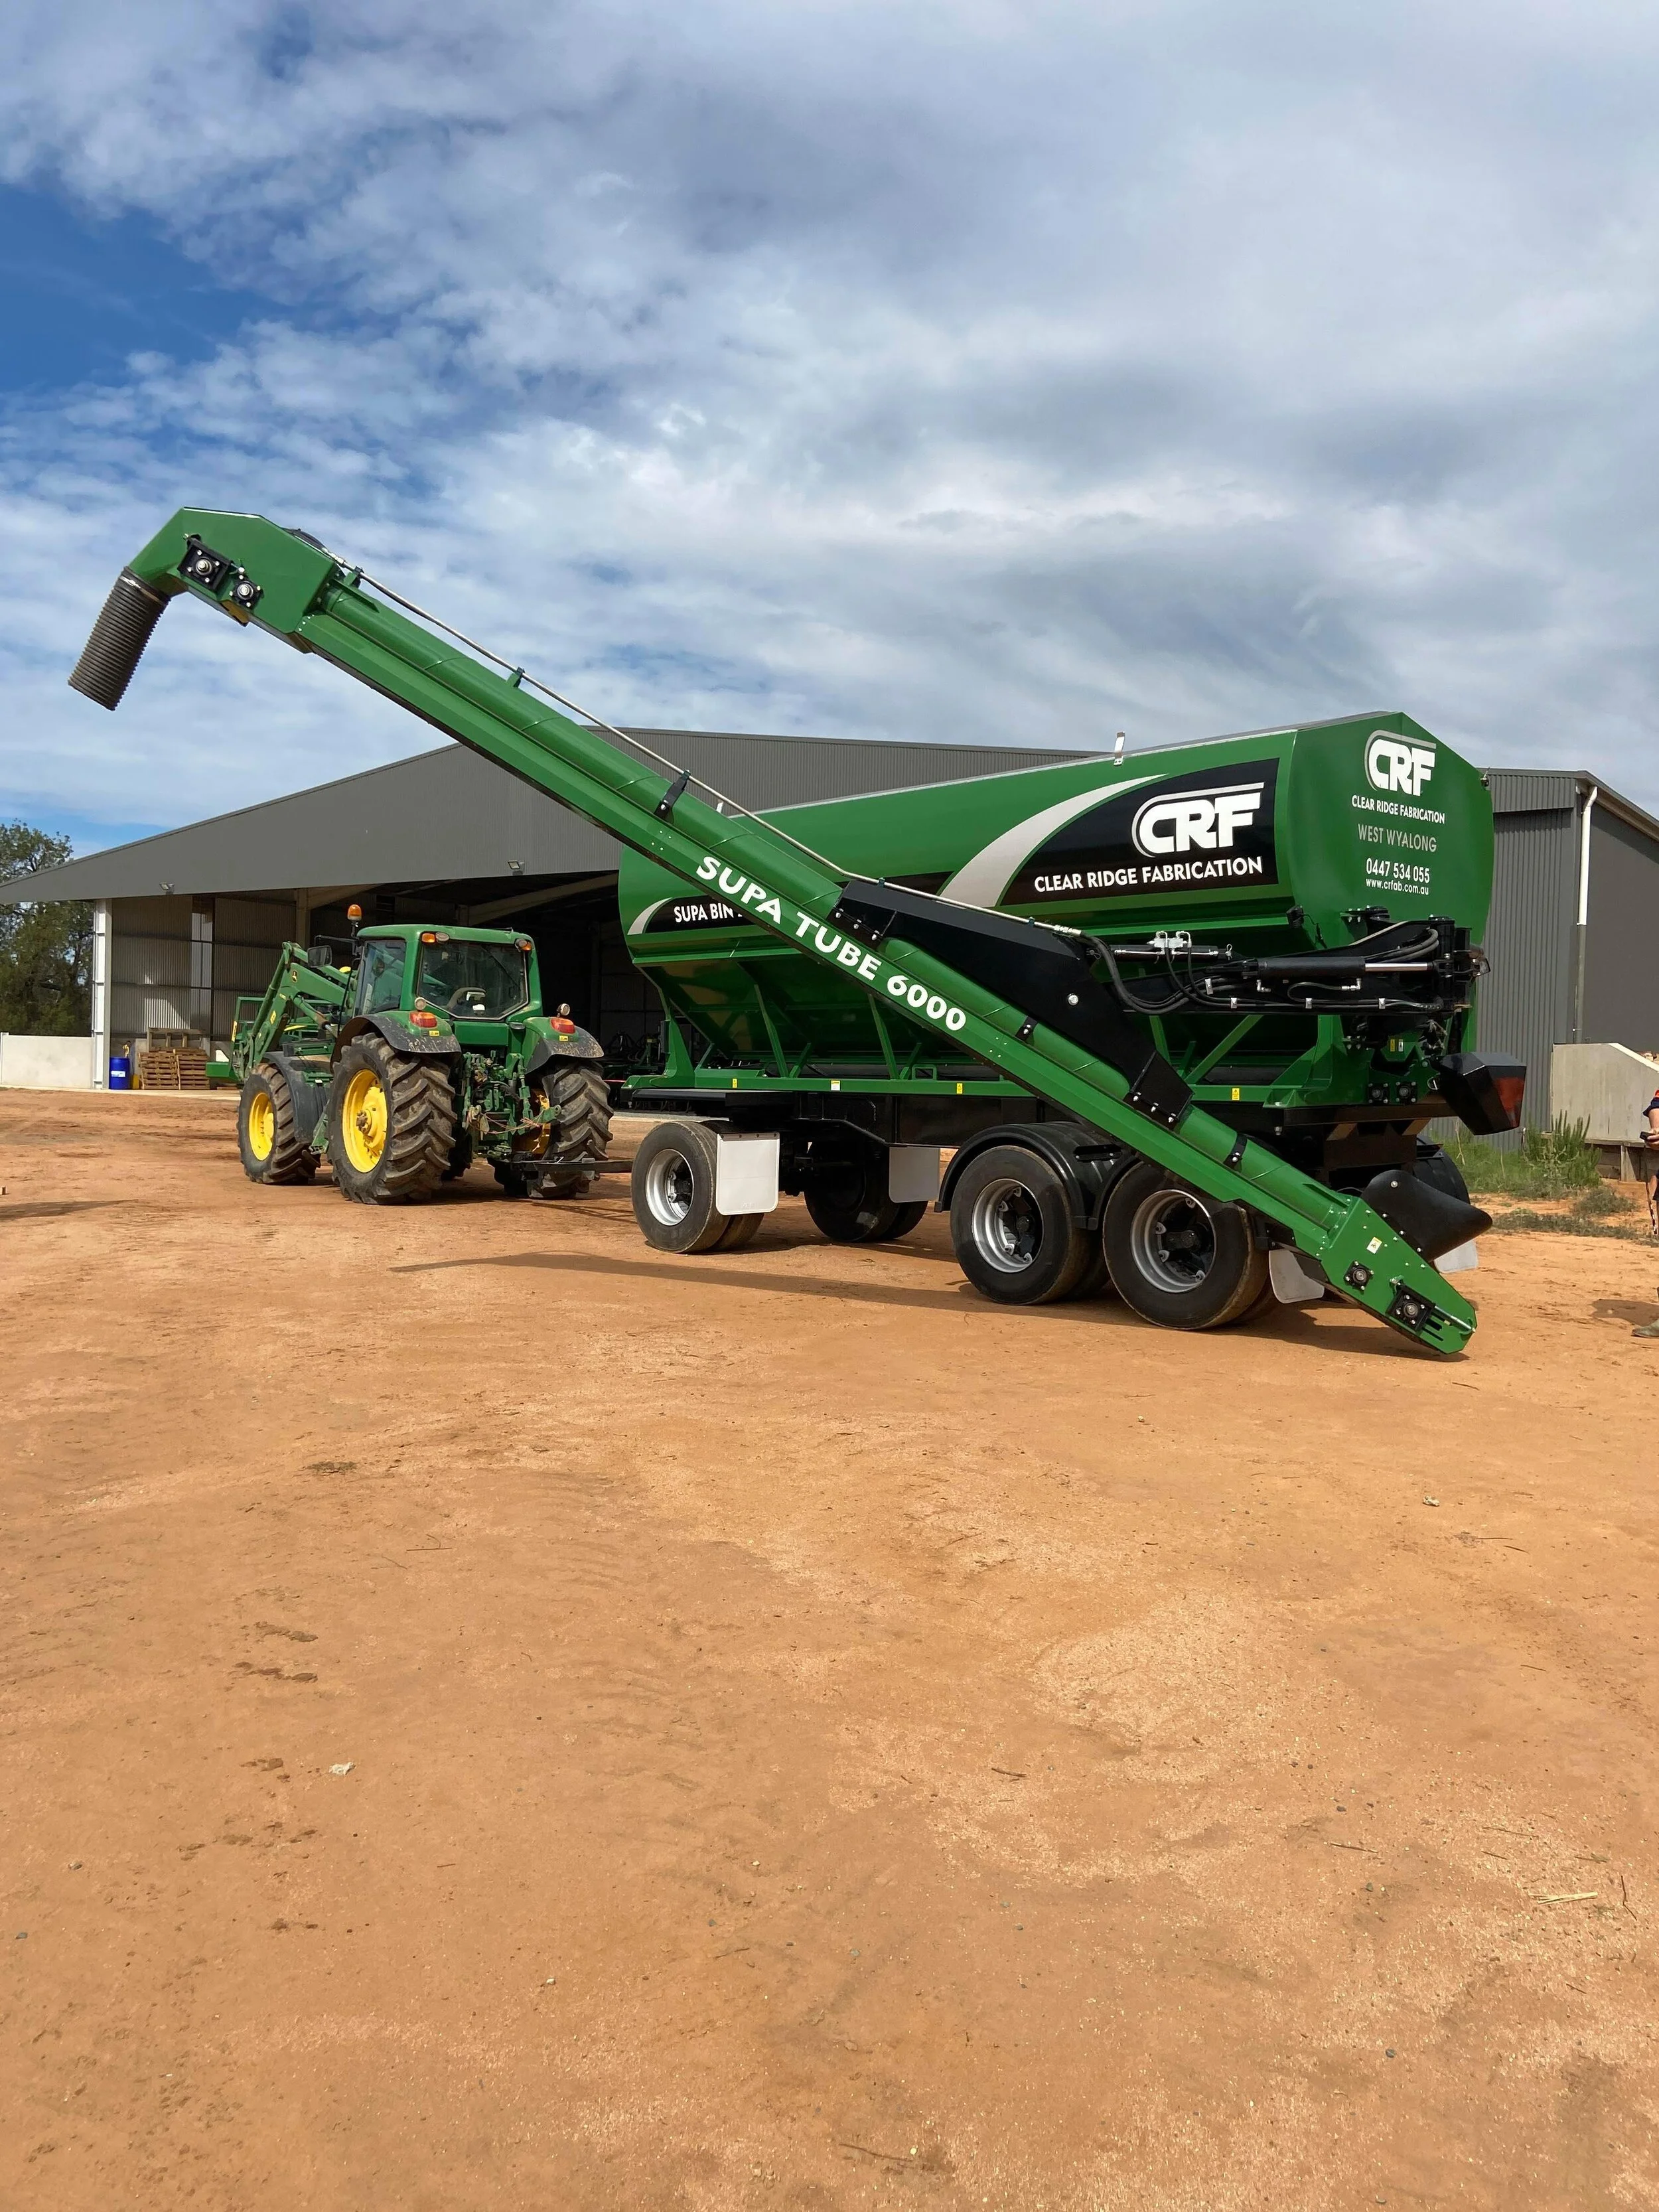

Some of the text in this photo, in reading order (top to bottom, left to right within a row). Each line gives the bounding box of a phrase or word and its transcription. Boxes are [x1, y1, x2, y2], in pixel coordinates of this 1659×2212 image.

[1368, 739, 1435, 796] CRF
[1139, 792, 1261, 854] CRF
[1352, 795, 1445, 824] CLEAR RIDGE FABRICATION
[1358, 824, 1437, 852] WEST WYALONG
[1034, 856, 1263, 893] CLEAR RIDGE FABRICATION
[1366, 857, 1429, 883] 0447 534 055
[1366, 878, 1429, 895] www.crfab.com.au
[674, 903, 734, 922] SUPA BIN
[696, 856, 966, 1031] SUPA TUBE 6000
